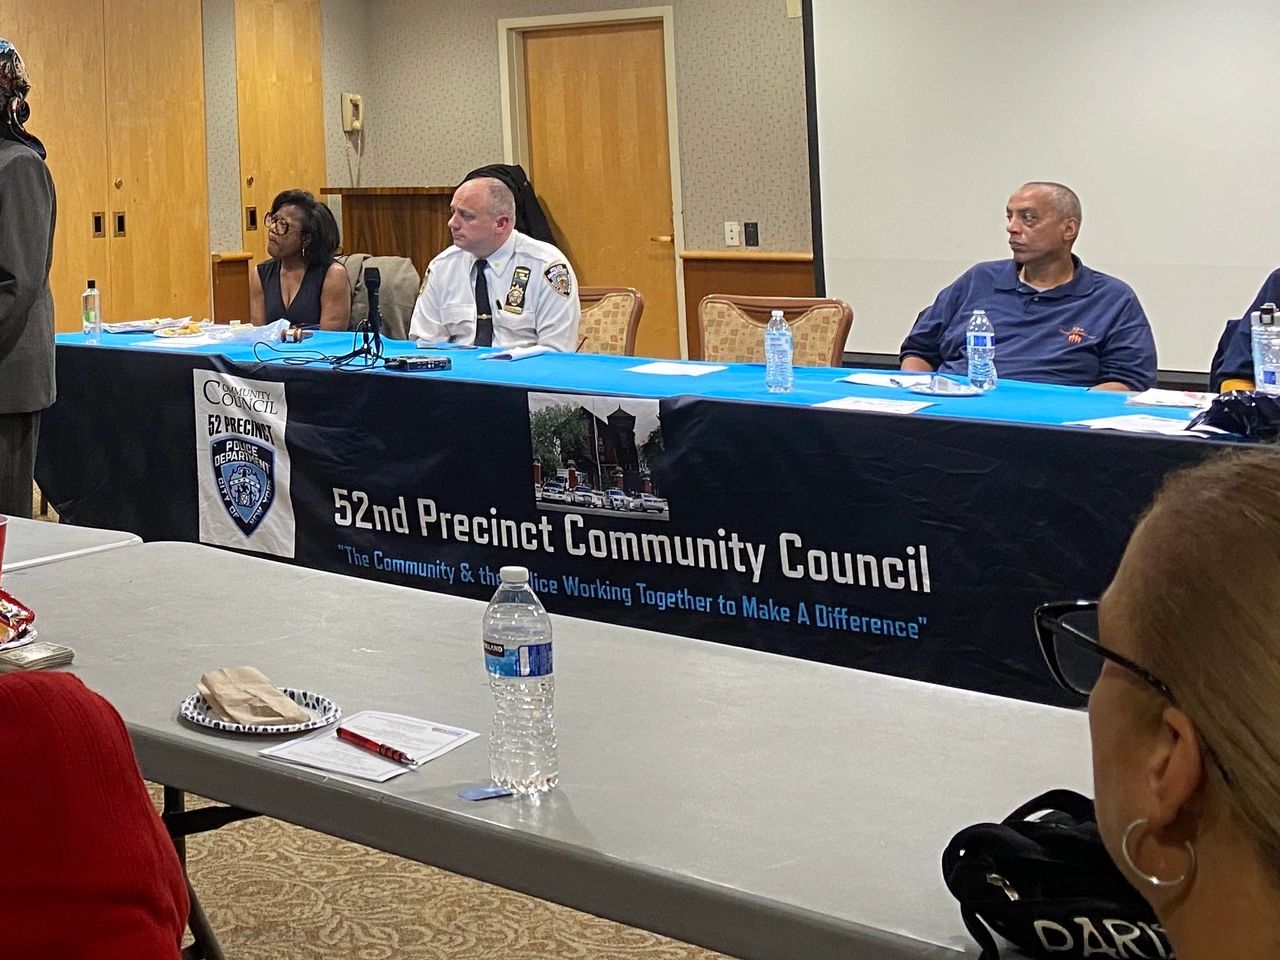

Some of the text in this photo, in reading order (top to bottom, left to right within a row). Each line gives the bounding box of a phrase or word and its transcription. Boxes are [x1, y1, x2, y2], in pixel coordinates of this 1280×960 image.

[208, 414, 275, 446] 52 PRECINCT
[214, 451, 271, 474] DEPARTMENT
[226, 441, 259, 458] POLICE
[218, 478, 240, 518] CITY OF
[333, 487, 931, 593] 52nd Precinct Community Council
[374, 550, 456, 584] Community
[461, 562, 476, 584] &
[529, 571, 558, 594] lice
[562, 575, 632, 606] Working
[636, 582, 713, 613] Together
[718, 595, 736, 616] to
[742, 595, 791, 622] Make
[797, 602, 811, 626] A
[815, 604, 927, 639] Difference"
